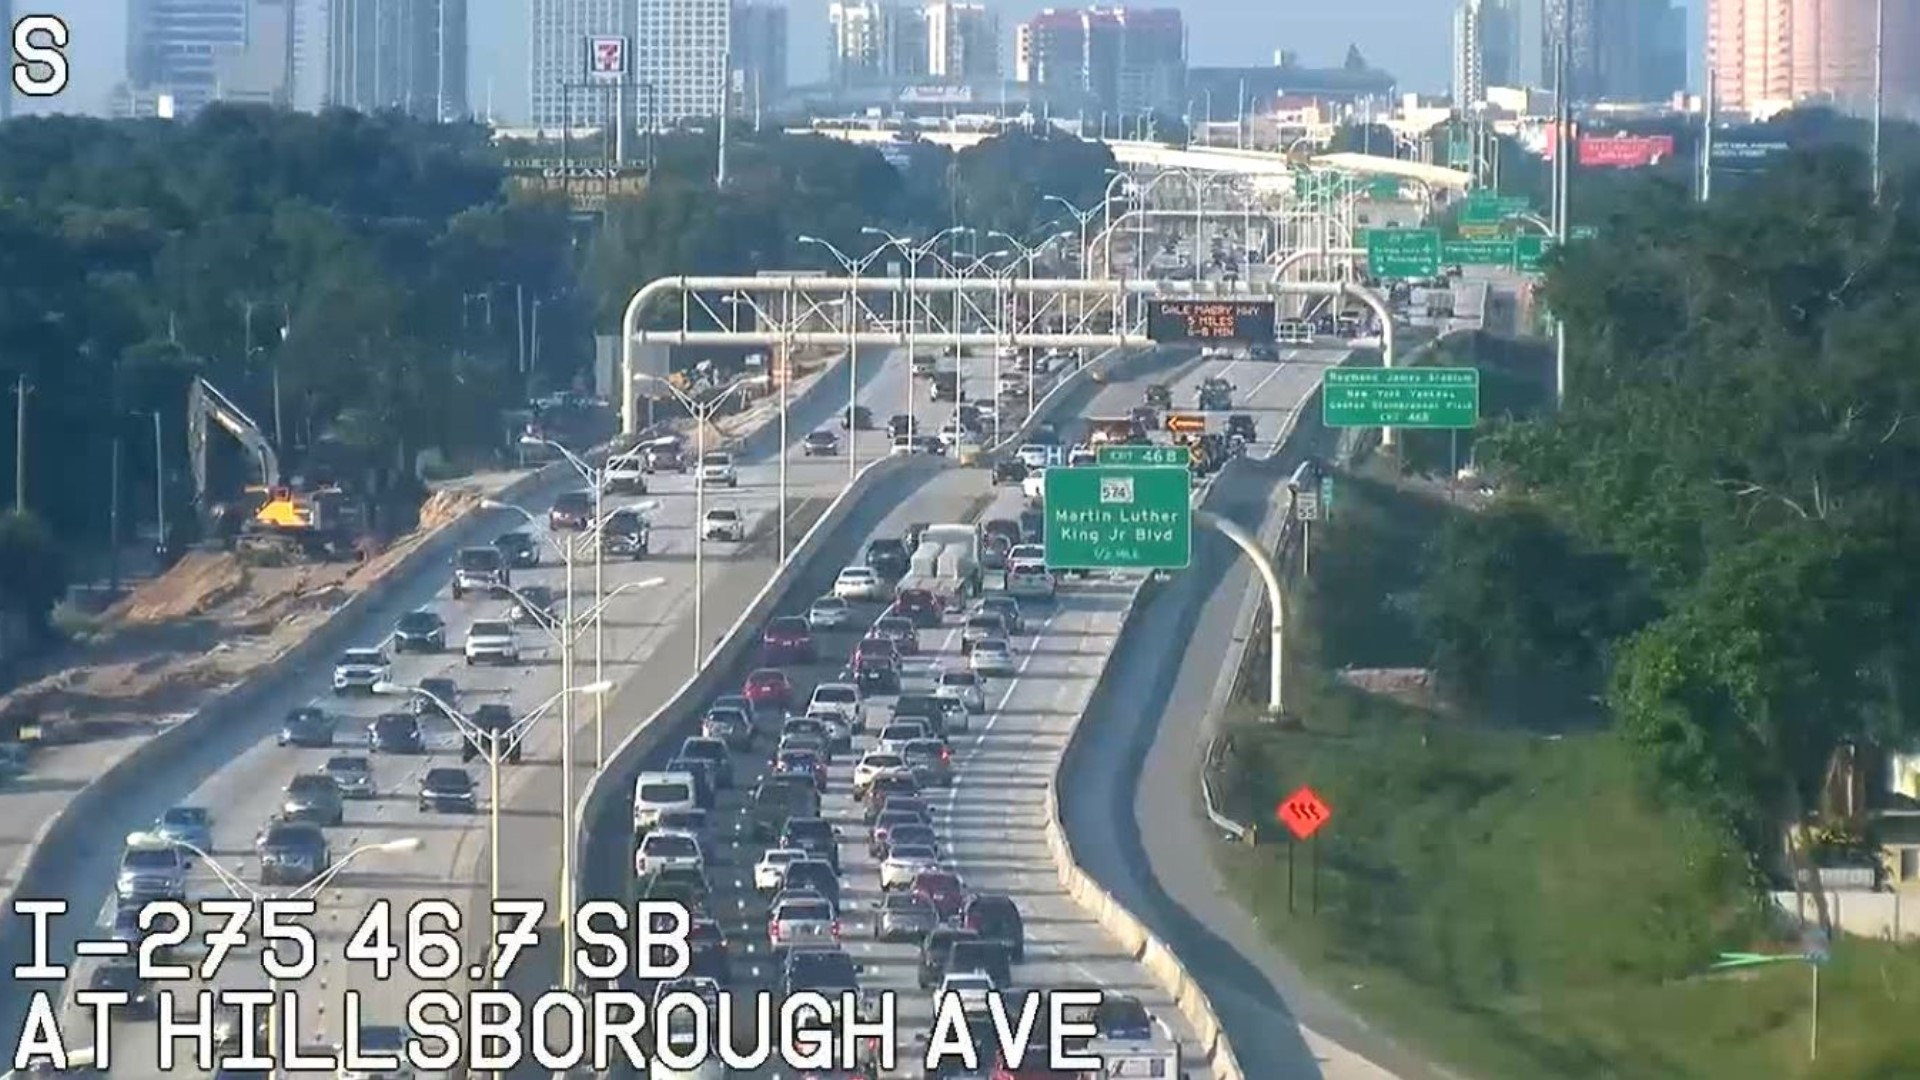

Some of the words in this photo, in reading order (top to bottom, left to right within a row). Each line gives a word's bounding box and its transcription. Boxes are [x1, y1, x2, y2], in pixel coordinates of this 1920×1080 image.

[543, 168, 620, 178] GALAXY
[1102, 486, 1126, 499] 574
[1056, 509, 1112, 522] Martin
[1120, 509, 1178, 522] Luther
[1061, 528, 1099, 544] King
[1108, 529, 1126, 541] Jr
[1136, 528, 1173, 541] Blvd
